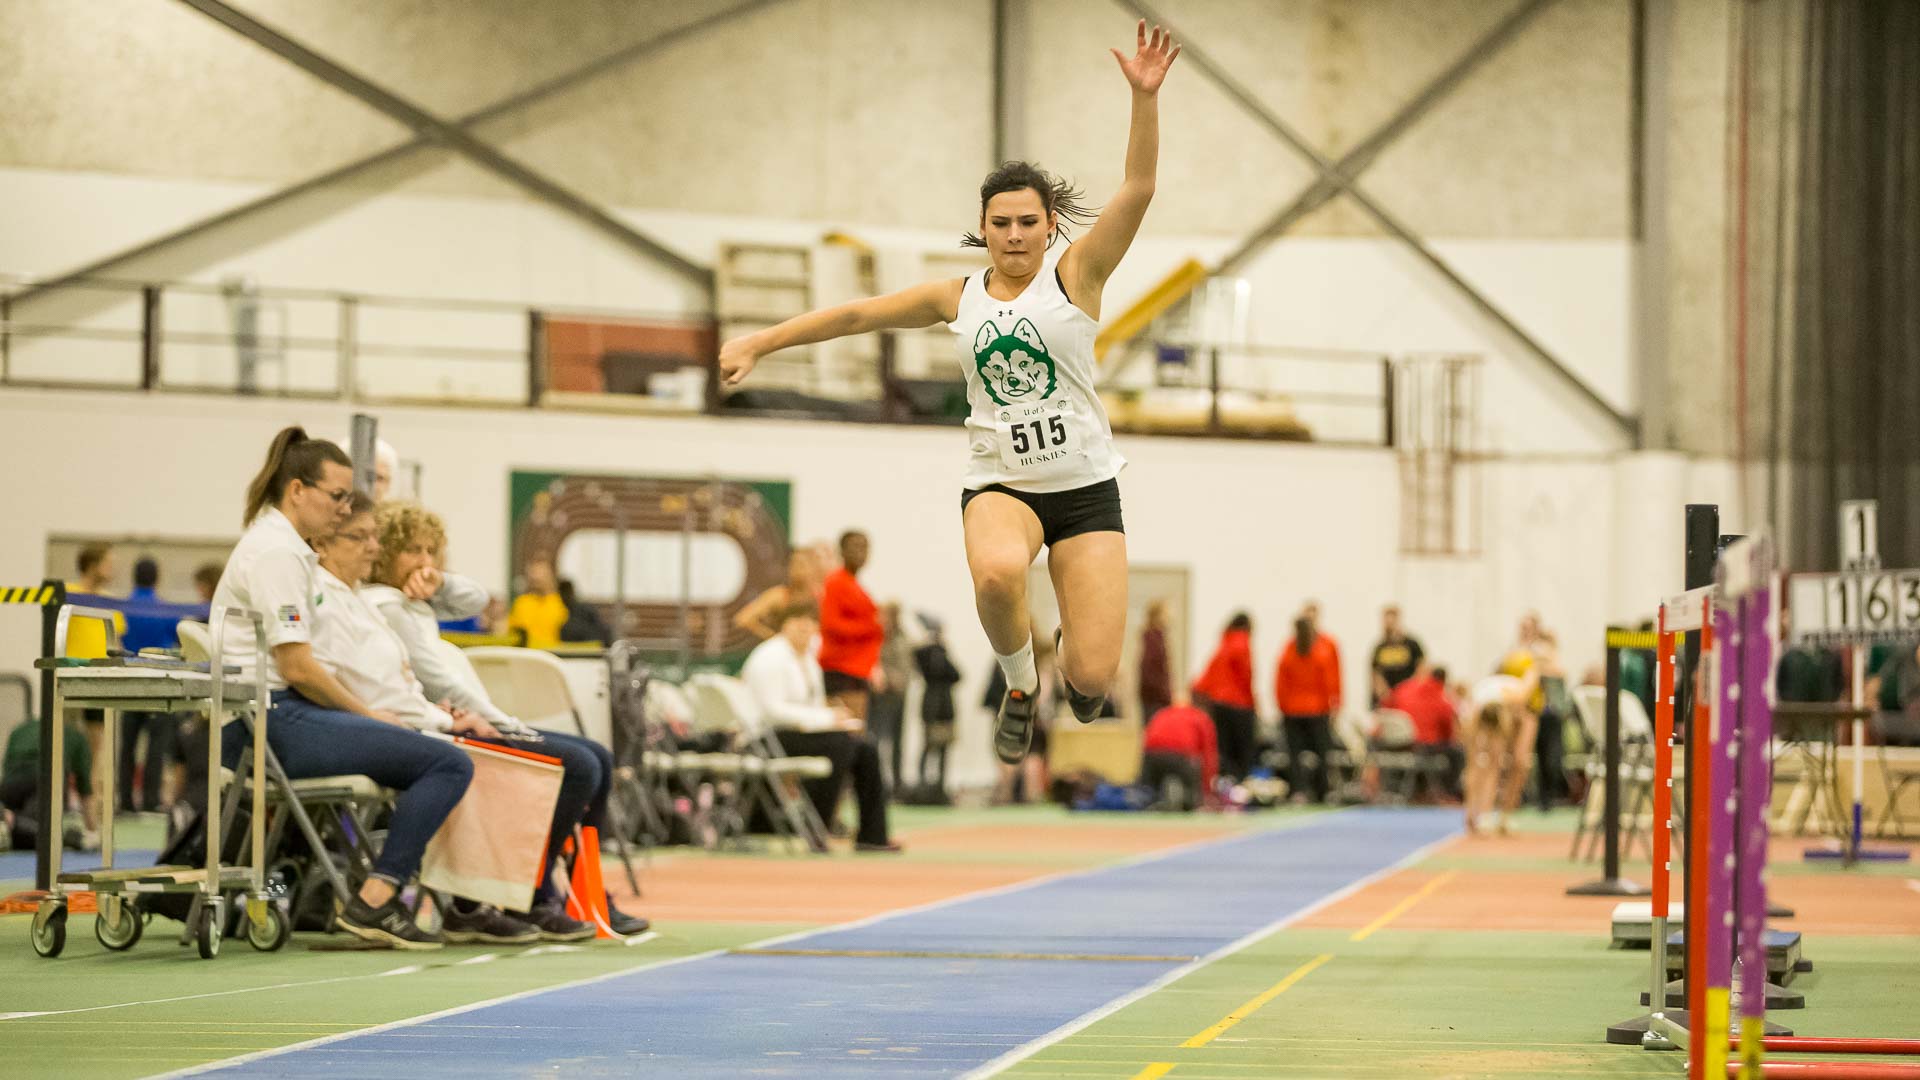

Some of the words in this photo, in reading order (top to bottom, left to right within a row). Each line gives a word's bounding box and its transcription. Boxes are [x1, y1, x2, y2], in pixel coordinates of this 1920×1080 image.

[1010, 414, 1067, 455] 515
[1020, 448, 1067, 466] HUSKIES
[1857, 508, 1865, 553] 1
